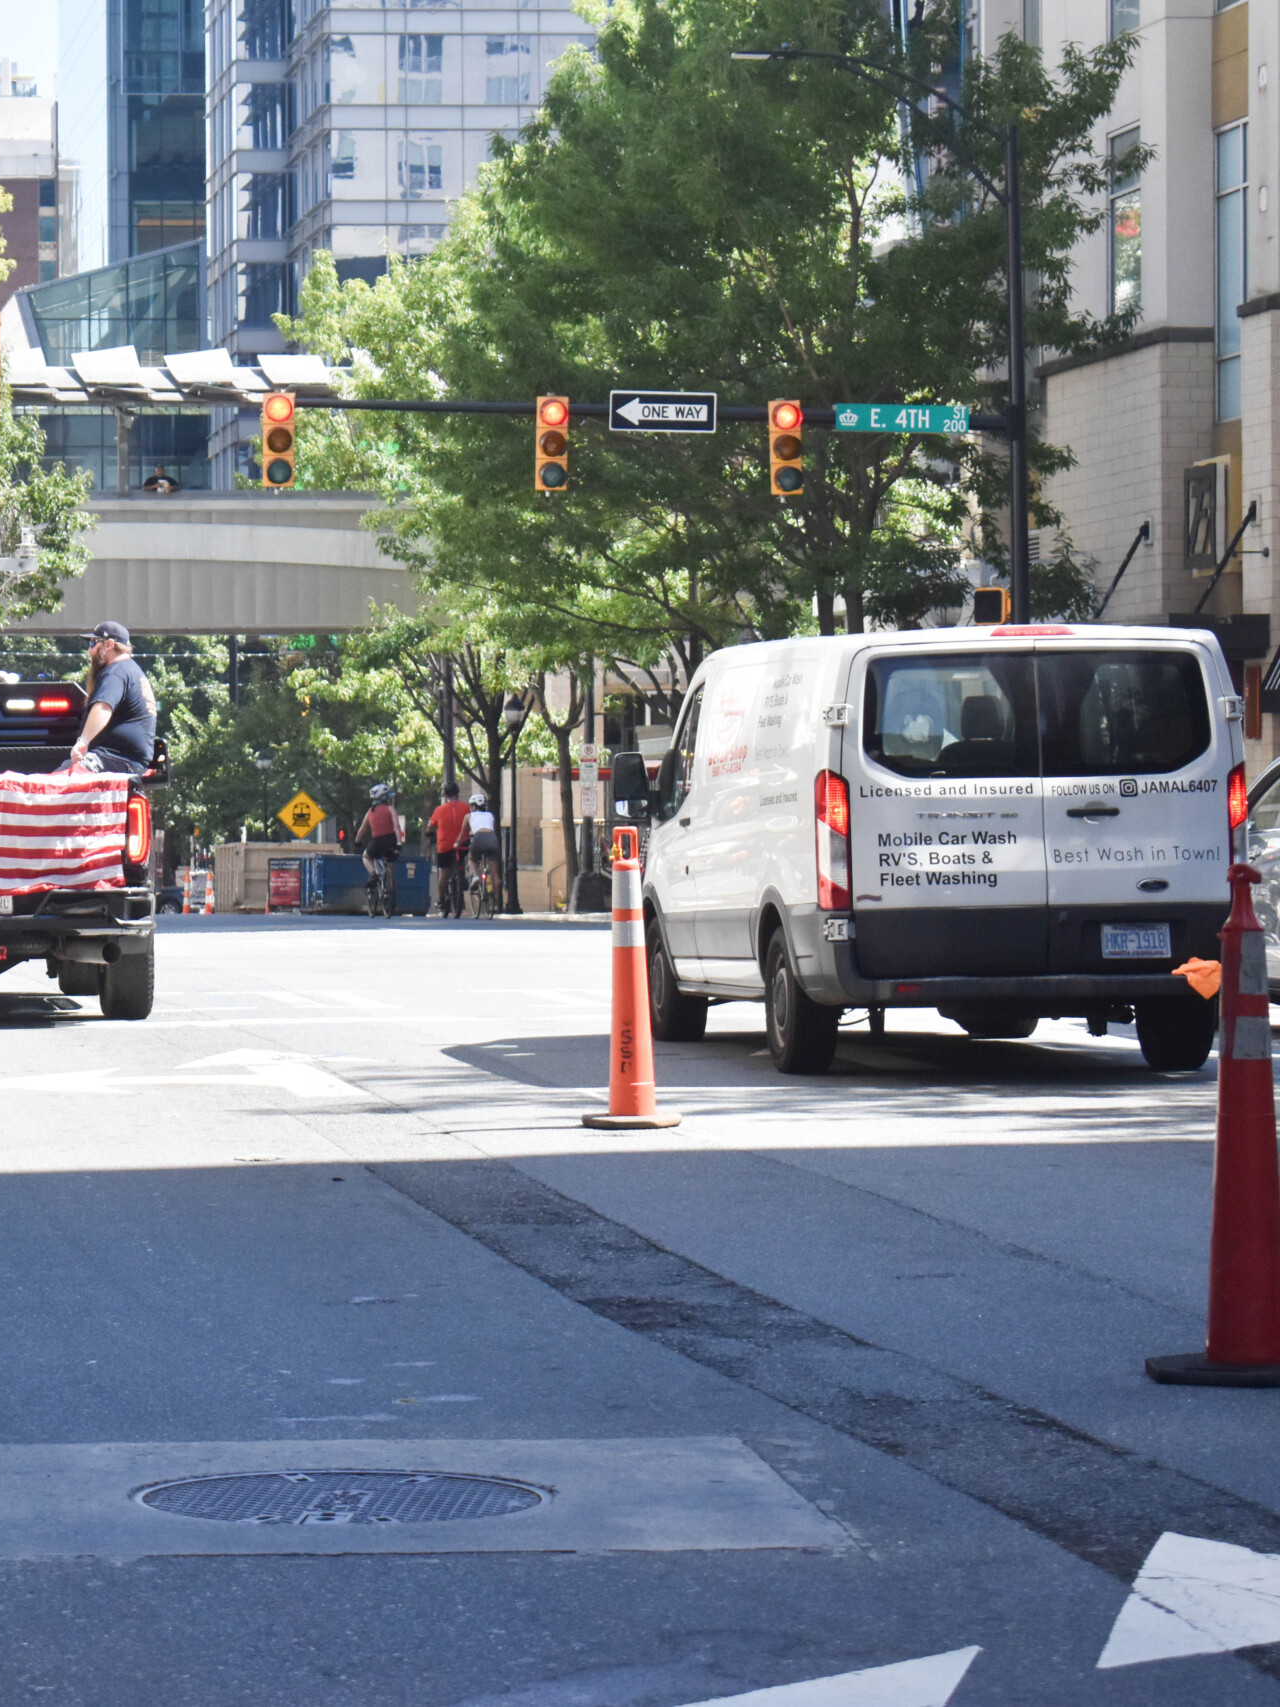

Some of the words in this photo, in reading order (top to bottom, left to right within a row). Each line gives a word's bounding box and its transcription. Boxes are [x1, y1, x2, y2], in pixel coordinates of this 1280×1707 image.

[641, 405, 672, 418] ONE
[674, 406, 704, 420] WAY
[870, 408, 888, 429] E.
[894, 408, 931, 430] 4TH
[952, 406, 967, 419] ST
[942, 418, 967, 433] 200
[859, 783, 934, 798] Licensed
[938, 782, 967, 797] and
[973, 781, 1034, 796] Insured
[1051, 784, 1087, 796] FOLLOW
[1088, 784, 1101, 795] US
[1102, 783, 1118, 795] ON:
[1141, 779, 1218, 795] JAMAL6407
[877, 832, 933, 848] Mobile
[938, 831, 967, 846] Car
[971, 830, 1018, 846] Wash
[929, 851, 976, 866] Boats
[981, 850, 994, 865] &
[1053, 848, 1090, 864] Best
[1096, 847, 1144, 862] Wash
[1150, 846, 1166, 861] in
[1173, 845, 1221, 861] Town!
[879, 872, 921, 887] Fleet
[926, 870, 998, 888] Washing
